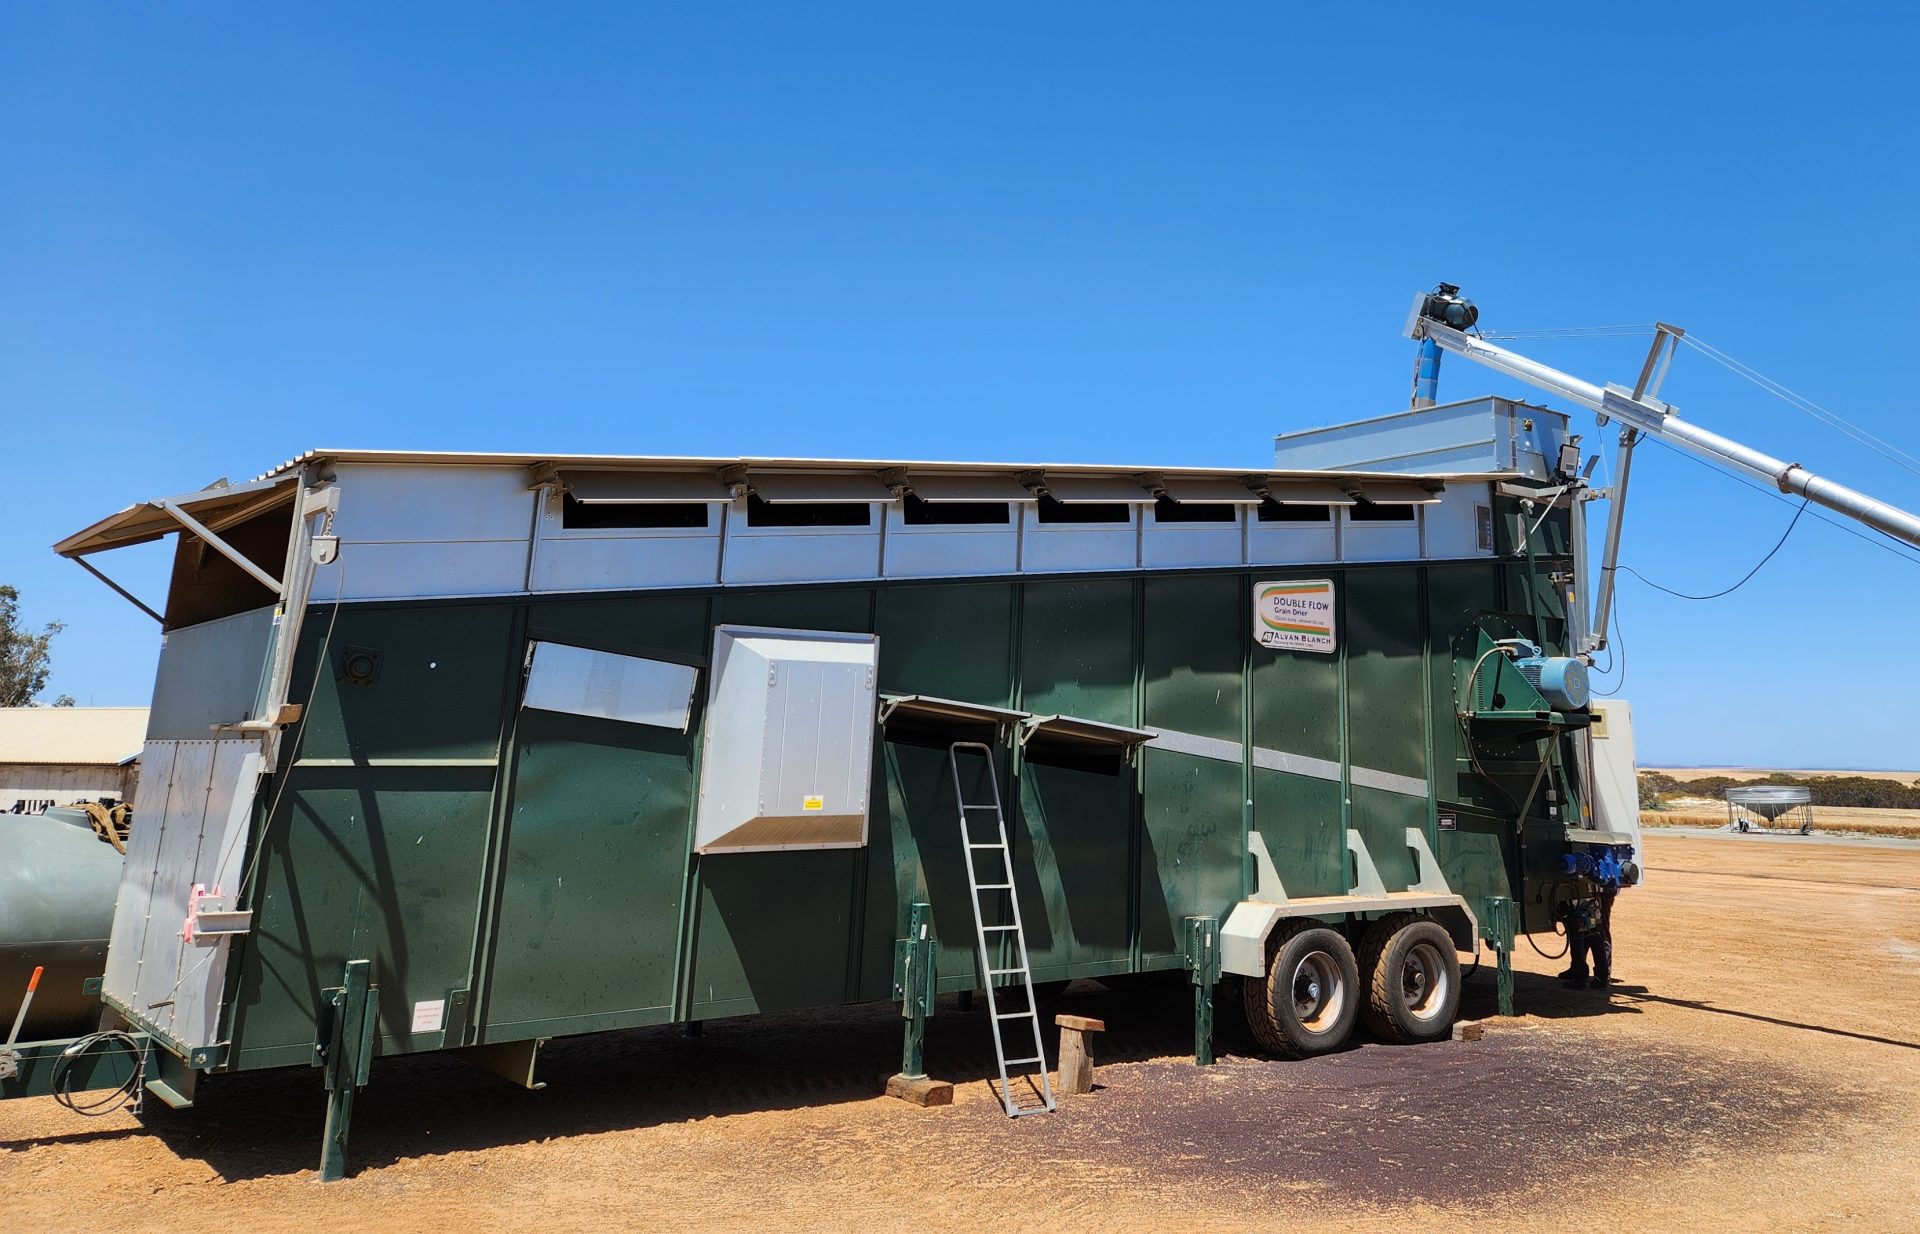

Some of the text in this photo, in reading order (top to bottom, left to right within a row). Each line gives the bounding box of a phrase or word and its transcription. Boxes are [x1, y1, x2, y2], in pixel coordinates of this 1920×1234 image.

[1274, 597, 1329, 610] DOUBLE FLOW
[1274, 632, 1299, 641] ALVAN
[1301, 635, 1331, 644] BLANCH
